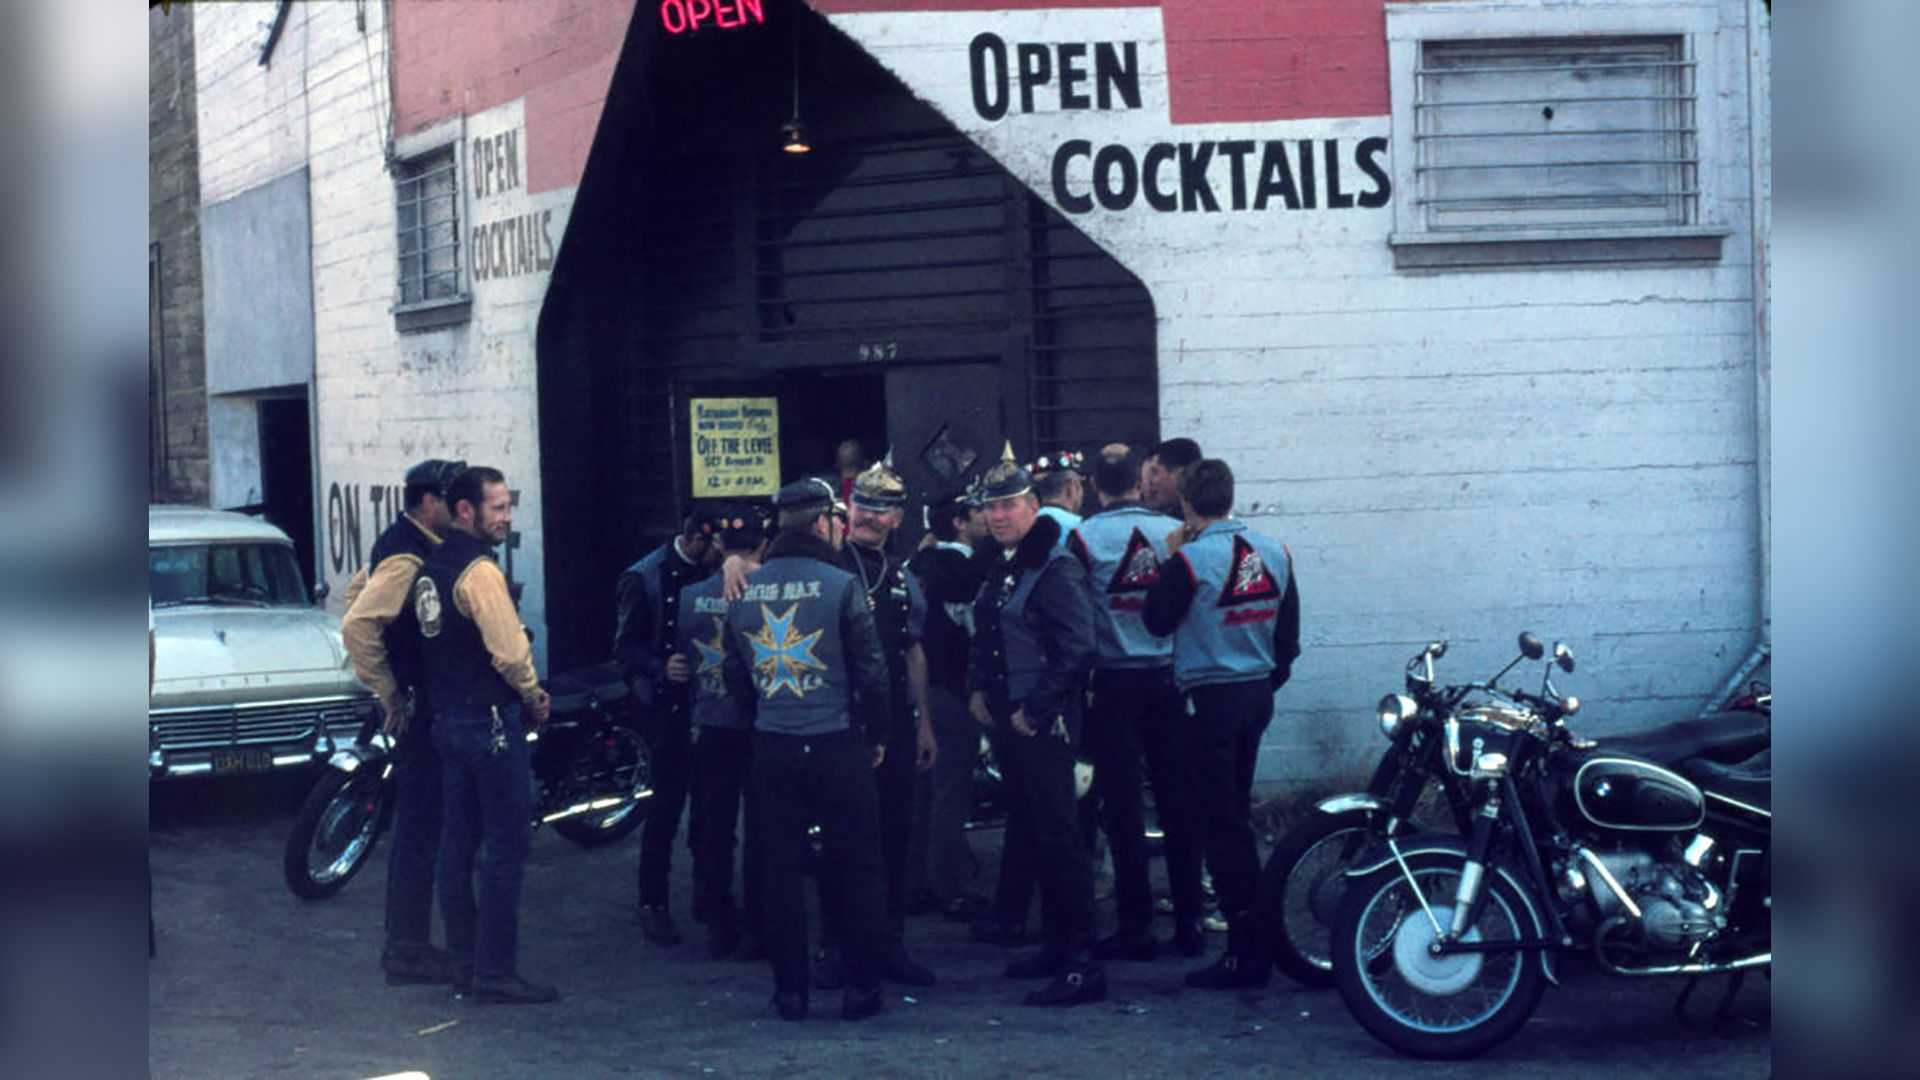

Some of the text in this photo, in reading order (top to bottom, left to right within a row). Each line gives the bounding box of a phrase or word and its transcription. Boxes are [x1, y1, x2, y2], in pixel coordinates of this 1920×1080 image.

[661, 0, 764, 33] OPEN
[969, 31, 1142, 122] OPEN
[472, 127, 518, 199] OPEN
[1051, 136, 1391, 214] COCKTAILS
[472, 209, 554, 282] COCKTAILS
[329, 482, 362, 574] ON
